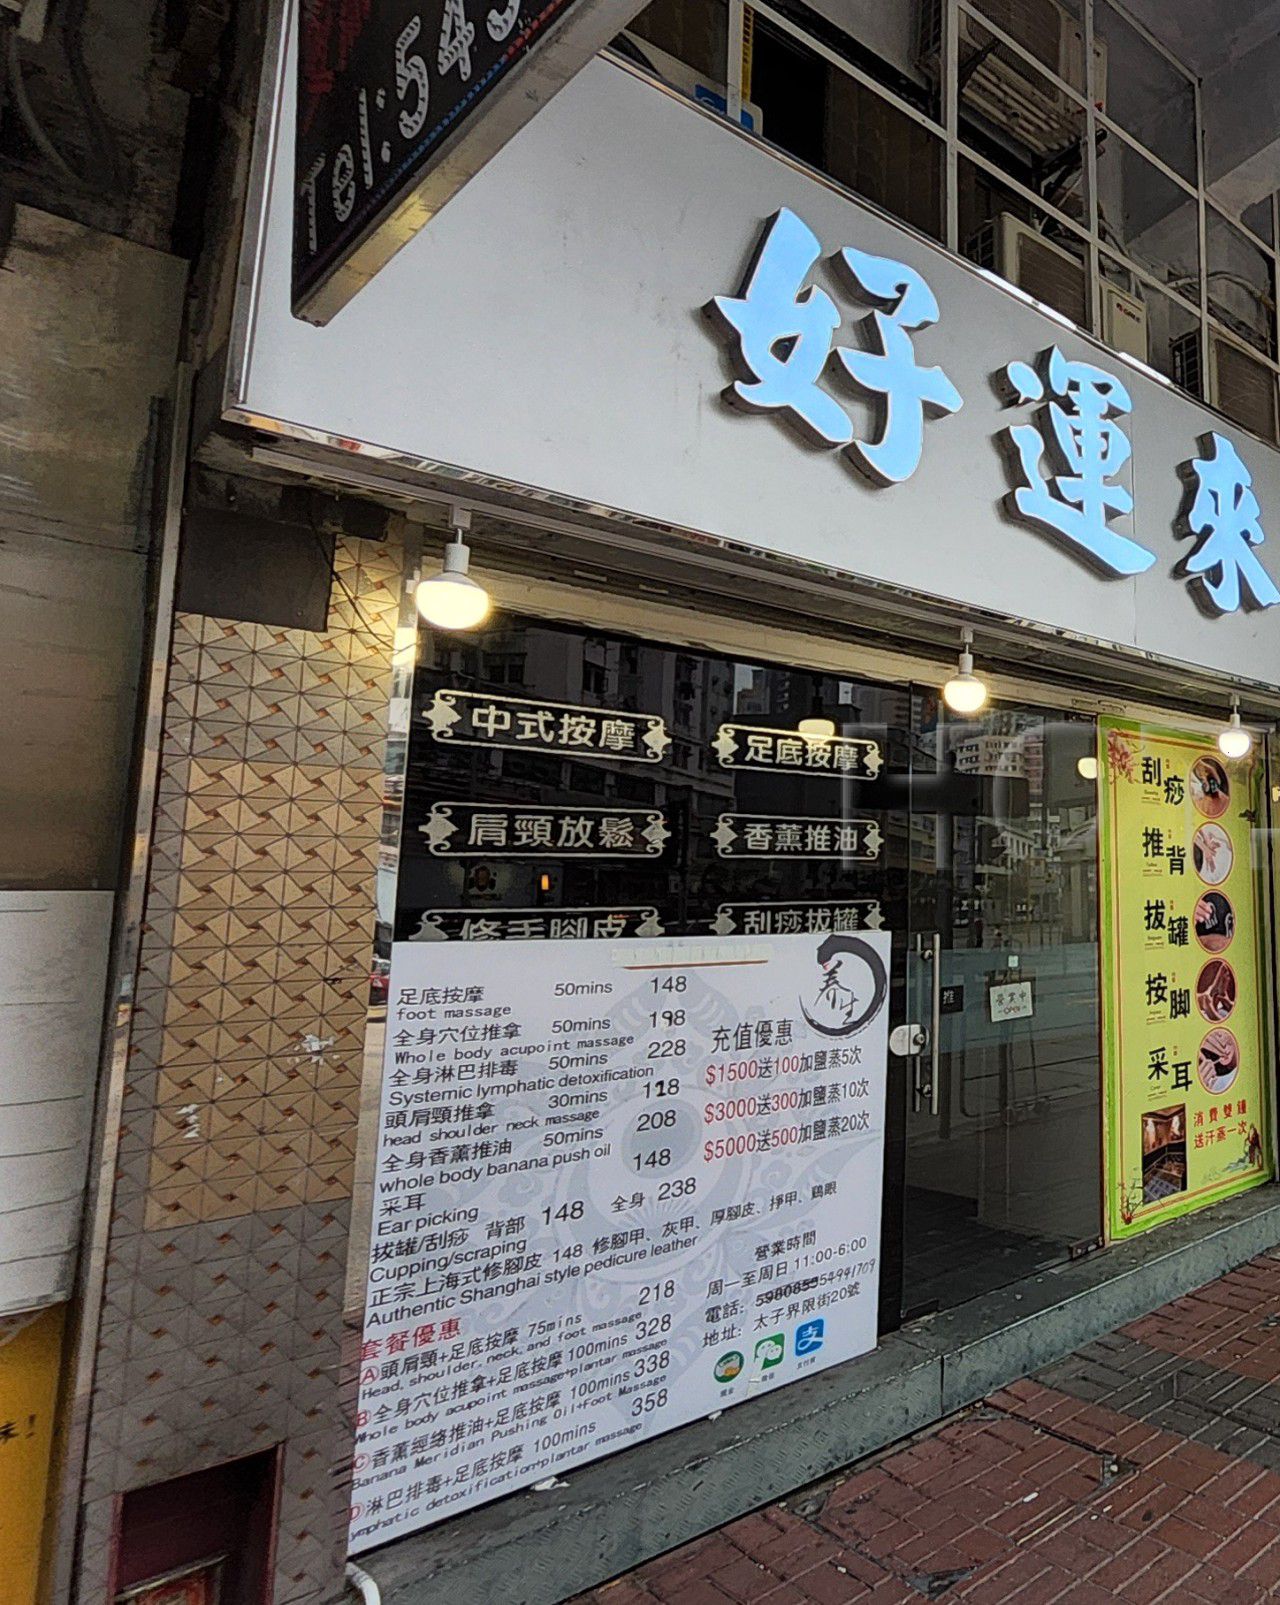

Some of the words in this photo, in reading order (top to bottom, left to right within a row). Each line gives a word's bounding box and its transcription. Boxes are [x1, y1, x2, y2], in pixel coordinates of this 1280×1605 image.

[472, 703, 636, 751] 中式按摩
[744, 734, 859, 771] 足底按摩
[1141, 756, 1185, 806] 刮痧
[468, 812, 635, 848] 肩頸放鬆
[744, 823, 858, 851] 香薰推油
[1142, 826, 1187, 876] 推背
[1144, 899, 1190, 948] 拔罐
[396, 985, 485, 1006] 足底按摩
[554, 981, 613, 998] 50mins
[650, 976, 687, 994] 148
[396, 1007, 437, 1021] foot
[443, 1004, 512, 1019] massage
[393, 1022, 523, 1048] 全身穴位推拿
[551, 1018, 611, 1034] 50mins
[649, 1009, 686, 1029] 198
[394, 1051, 446, 1065] Whole
[453, 1047, 493, 1062] body
[500, 1039, 571, 1058] acupoint
[576, 1034, 635, 1050] massage
[710, 1018, 794, 1054] 充值優惠
[388, 1059, 519, 1088] 全身淋巴排毒
[548, 1052, 609, 1070] 50mins
[647, 1038, 687, 1060] 228
[1147, 1046, 1193, 1092] 采耳
[384, 1101, 497, 1129] 頭肩頸推拿
[548, 1090, 608, 1109] 30mins
[643, 1078, 680, 1099] 118
[388, 1086, 474, 1109] Systemic
[477, 1077, 555, 1102] lymphatic
[558, 1066, 654, 1088] detoxification
[382, 1131, 422, 1147] head
[429, 1123, 498, 1141] shoulder
[506, 1117, 539, 1132] neck
[545, 1109, 600, 1126] massage
[543, 1127, 604, 1147] 50mins
[636, 1109, 677, 1132] 208
[379, 1170, 435, 1194] whole
[439, 1165, 484, 1187] body
[486, 1157, 549, 1178] banana
[551, 1150, 591, 1169] push
[593, 1144, 611, 1159] oil
[379, 1192, 427, 1217] 采耳
[633, 1148, 671, 1171] 148
[370, 1227, 471, 1266] 拔罐/刮痧
[484, 1215, 526, 1241] 背部
[541, 1200, 586, 1226] 148
[610, 1191, 646, 1214] 全身
[657, 1177, 697, 1201] 238
[377, 1219, 412, 1238] Ear
[415, 1205, 479, 1231] picking
[369, 1238, 527, 1284] Cupping/scraping
[552, 1243, 584, 1264] 148
[706, 1261, 788, 1300] 周一至周日
[794, 1237, 867, 1270] 11:00-6:00
[366, 1294, 457, 1328] Authentic
[459, 1271, 541, 1306] Shanghai
[543, 1264, 581, 1285] style
[584, 1249, 648, 1275] pedicure
[650, 1234, 698, 1256] leather
[526, 1336, 551, 1352] and
[557, 1328, 587, 1343] foot
[592, 1311, 642, 1333] massage
[528, 1314, 583, 1338] 75mins
[638, 1279, 675, 1306] 218
[360, 1317, 462, 1362] 套餐優惠
[568, 1333, 628, 1362] 100mins
[635, 1313, 671, 1340] 328
[404, 1409, 440, 1430] body
[445, 1390, 508, 1417] acupoint
[622, 1337, 667, 1360] massage
[570, 1370, 630, 1400] 100mins
[634, 1350, 670, 1378] 338
[351, 1465, 407, 1490] Banana
[414, 1438, 484, 1469] Meridian
[491, 1416, 547, 1441] Pushing
[618, 1374, 667, 1397] Massage
[534, 1421, 596, 1453] 100mins
[631, 1387, 668, 1417] 358
[595, 1422, 643, 1446] massage
